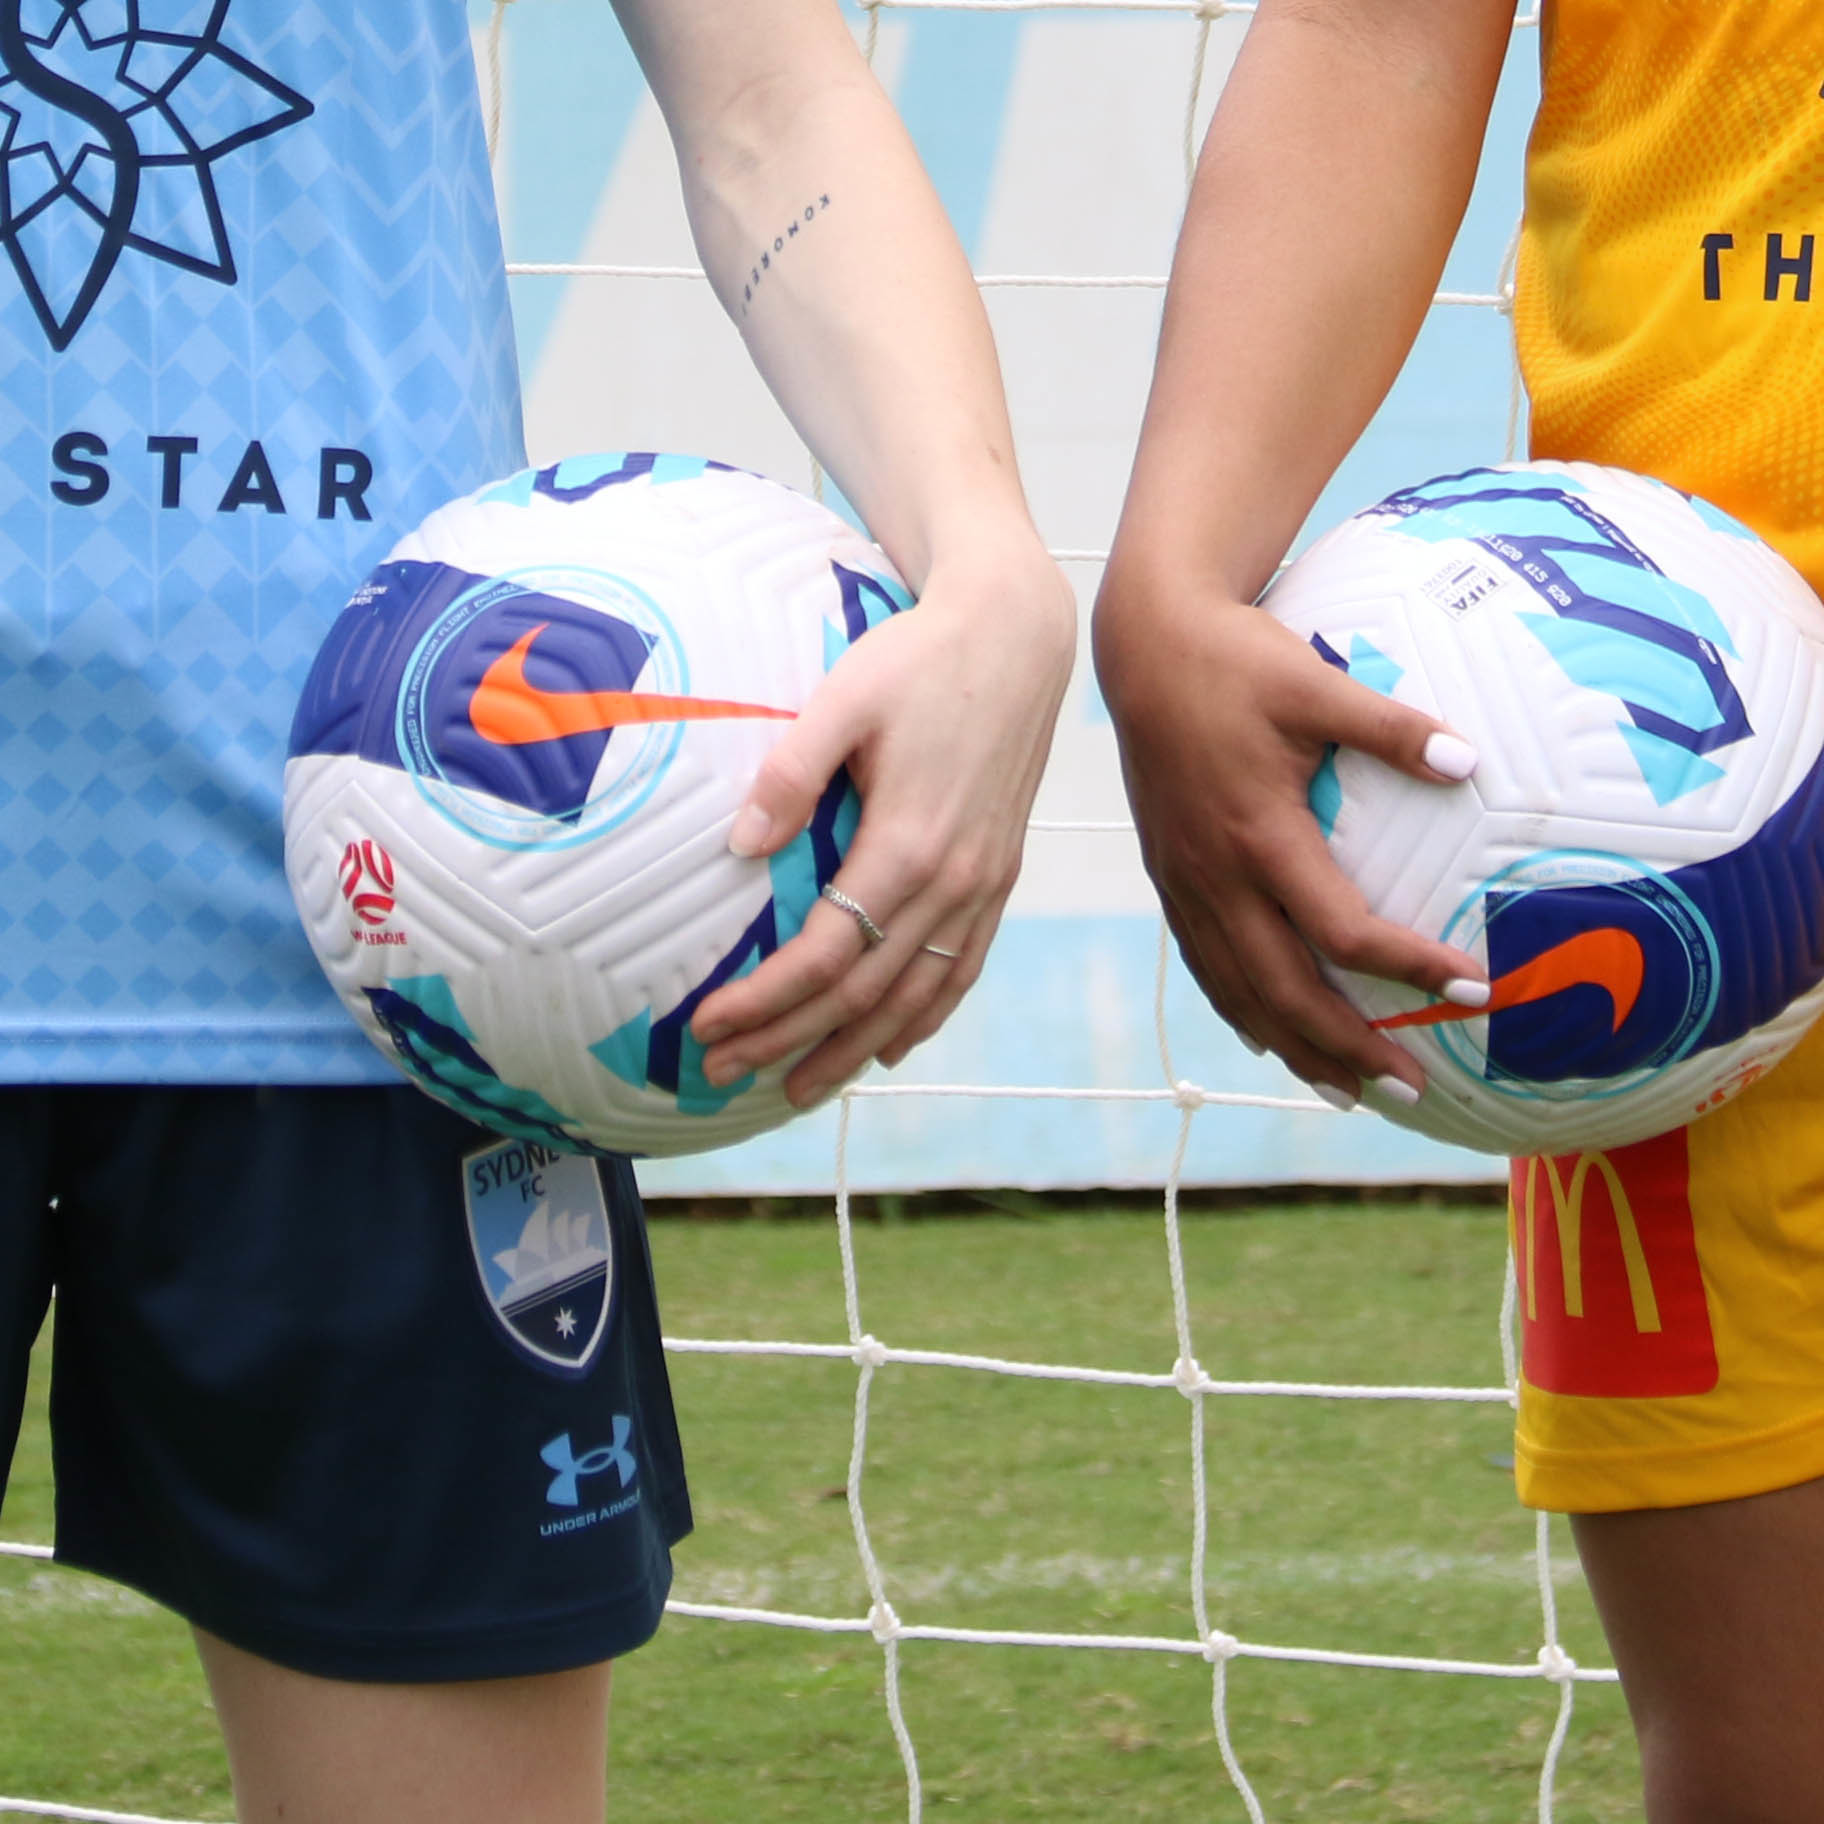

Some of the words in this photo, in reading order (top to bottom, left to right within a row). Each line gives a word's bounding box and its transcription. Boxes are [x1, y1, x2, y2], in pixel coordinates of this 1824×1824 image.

[49, 431, 374, 521] STAR
[1449, 576, 1499, 612] FIFA
[473, 1140, 561, 1197] SYDN
[519, 1174, 546, 1204] FC
[540, 1512, 597, 1537] UNDER
